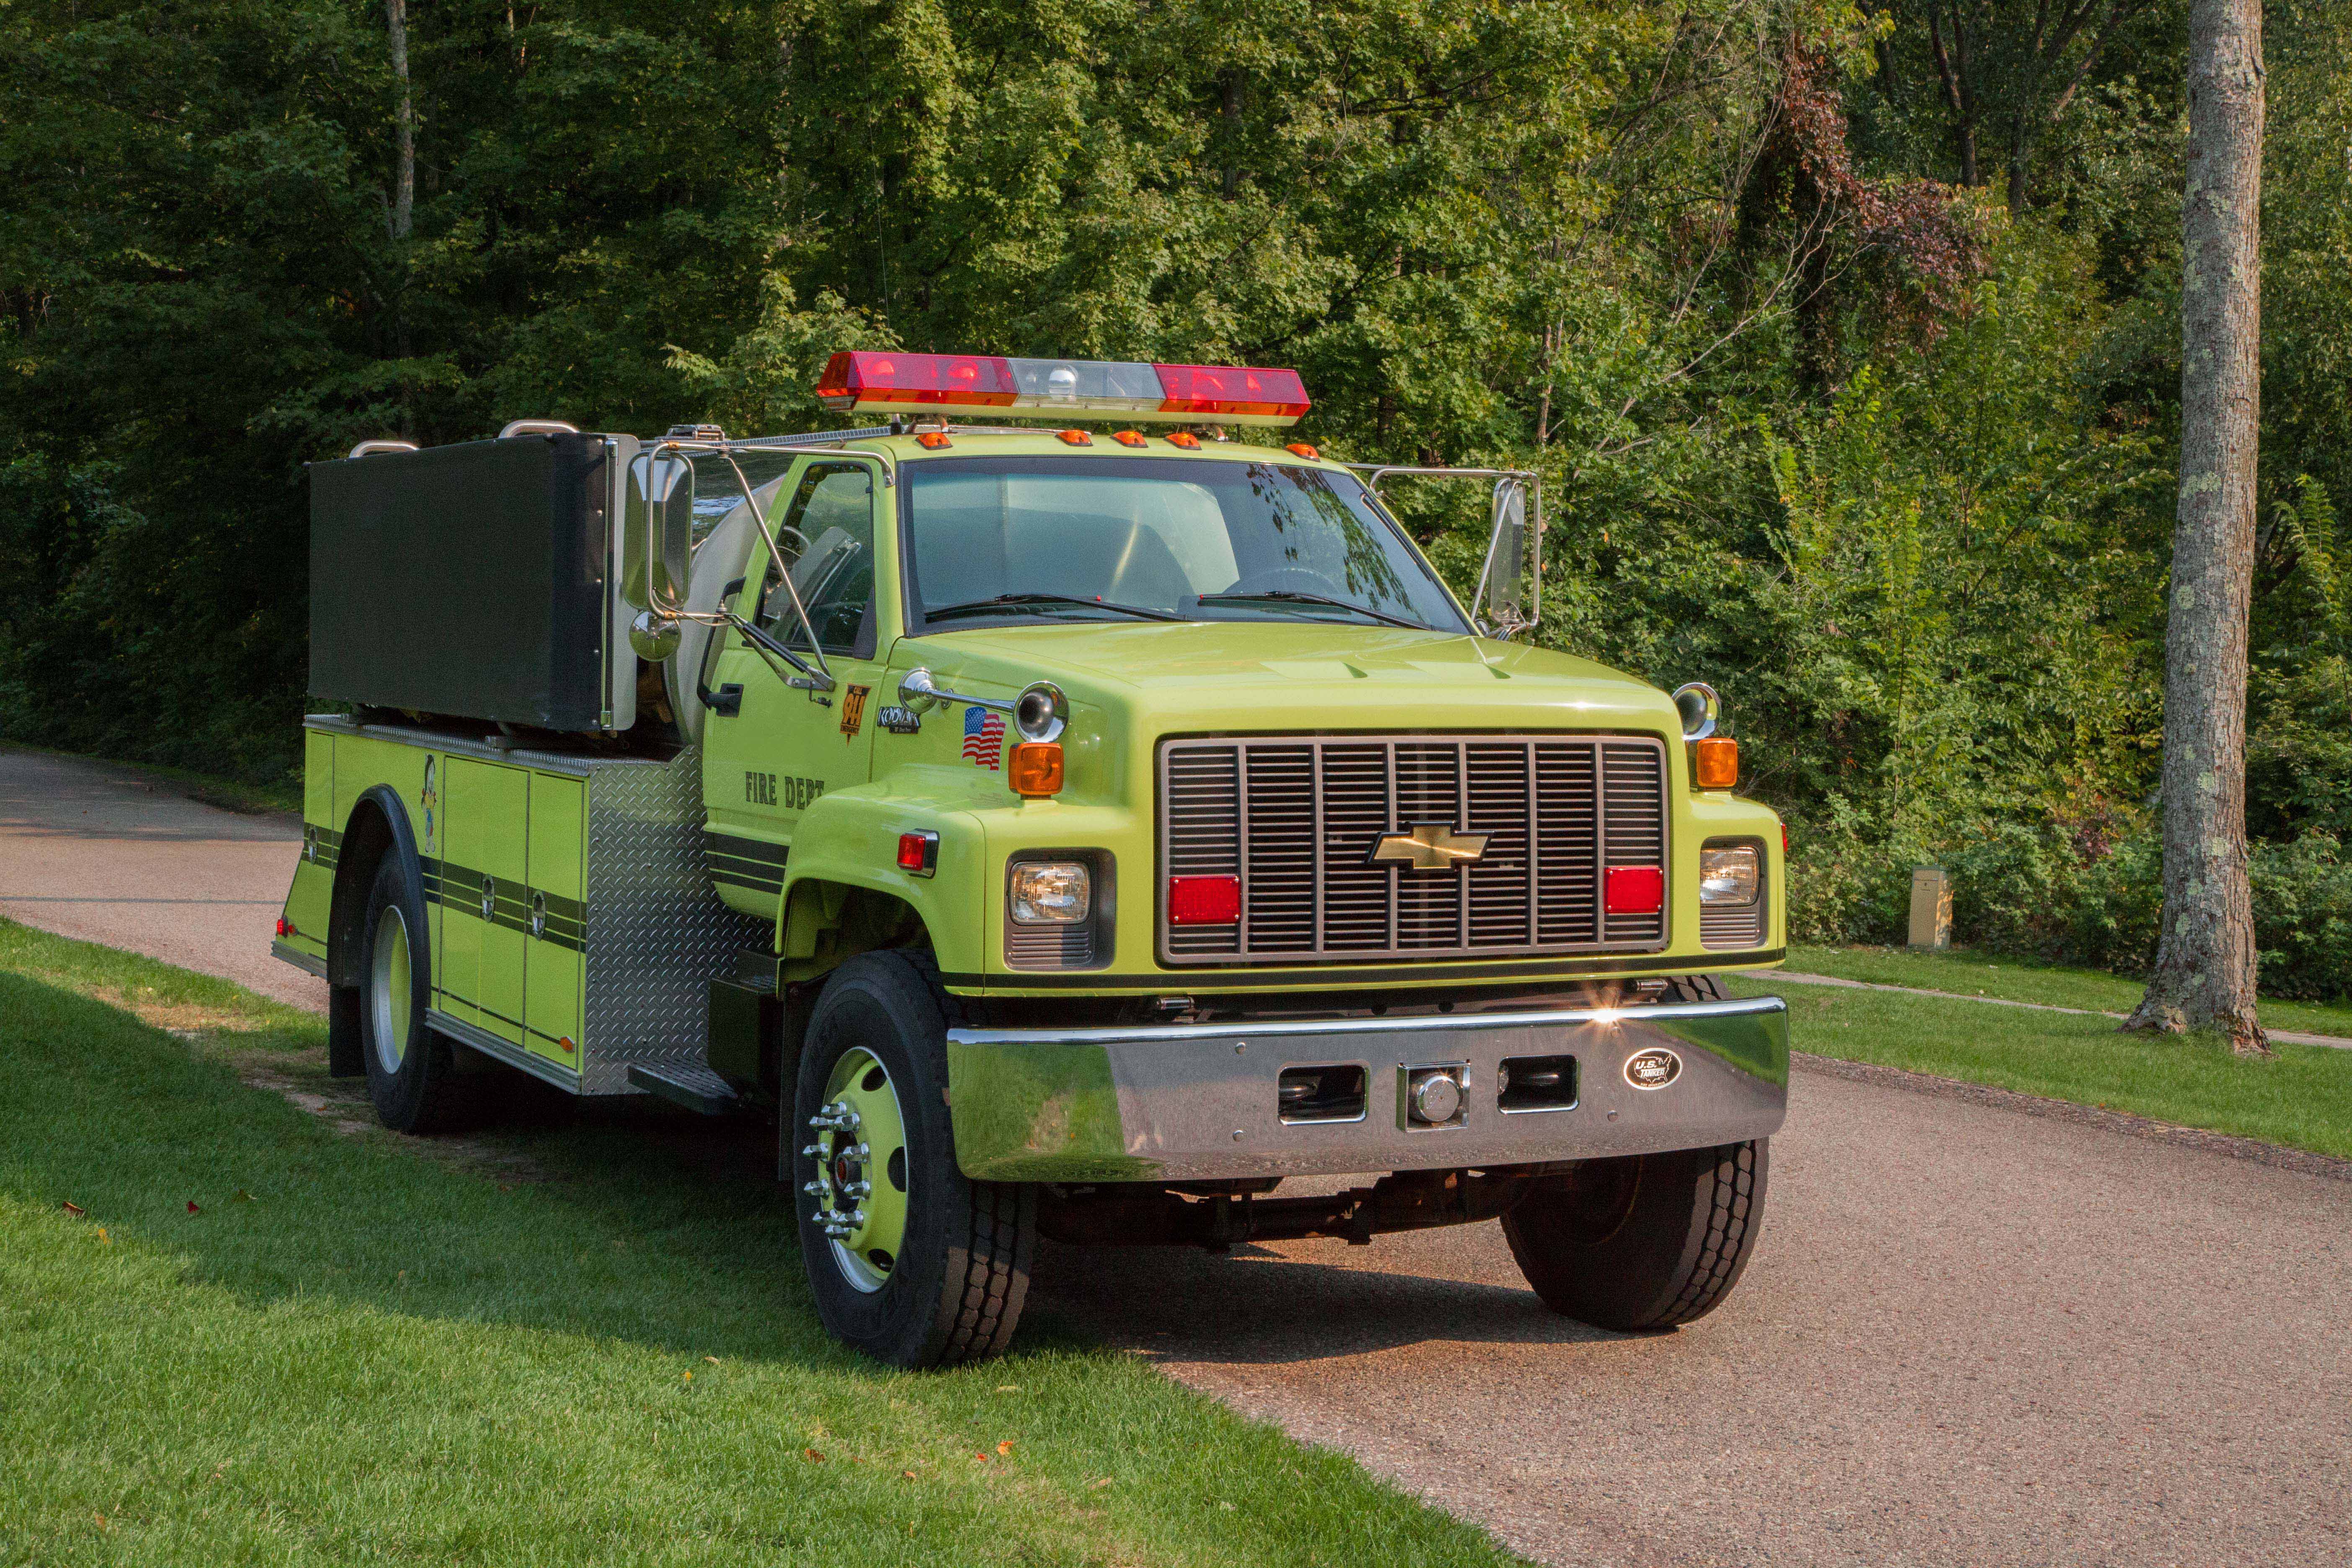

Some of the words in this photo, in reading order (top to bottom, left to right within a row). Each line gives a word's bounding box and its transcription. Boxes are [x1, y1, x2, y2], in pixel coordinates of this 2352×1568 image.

[843, 694, 865, 726] 911
[878, 707, 919, 726] KODIAK
[745, 771, 777, 805] FIRE
[785, 776, 824, 810] DEPT
[1635, 1061, 1657, 1069] U.S.
[1640, 1068, 1666, 1078] TANKER
